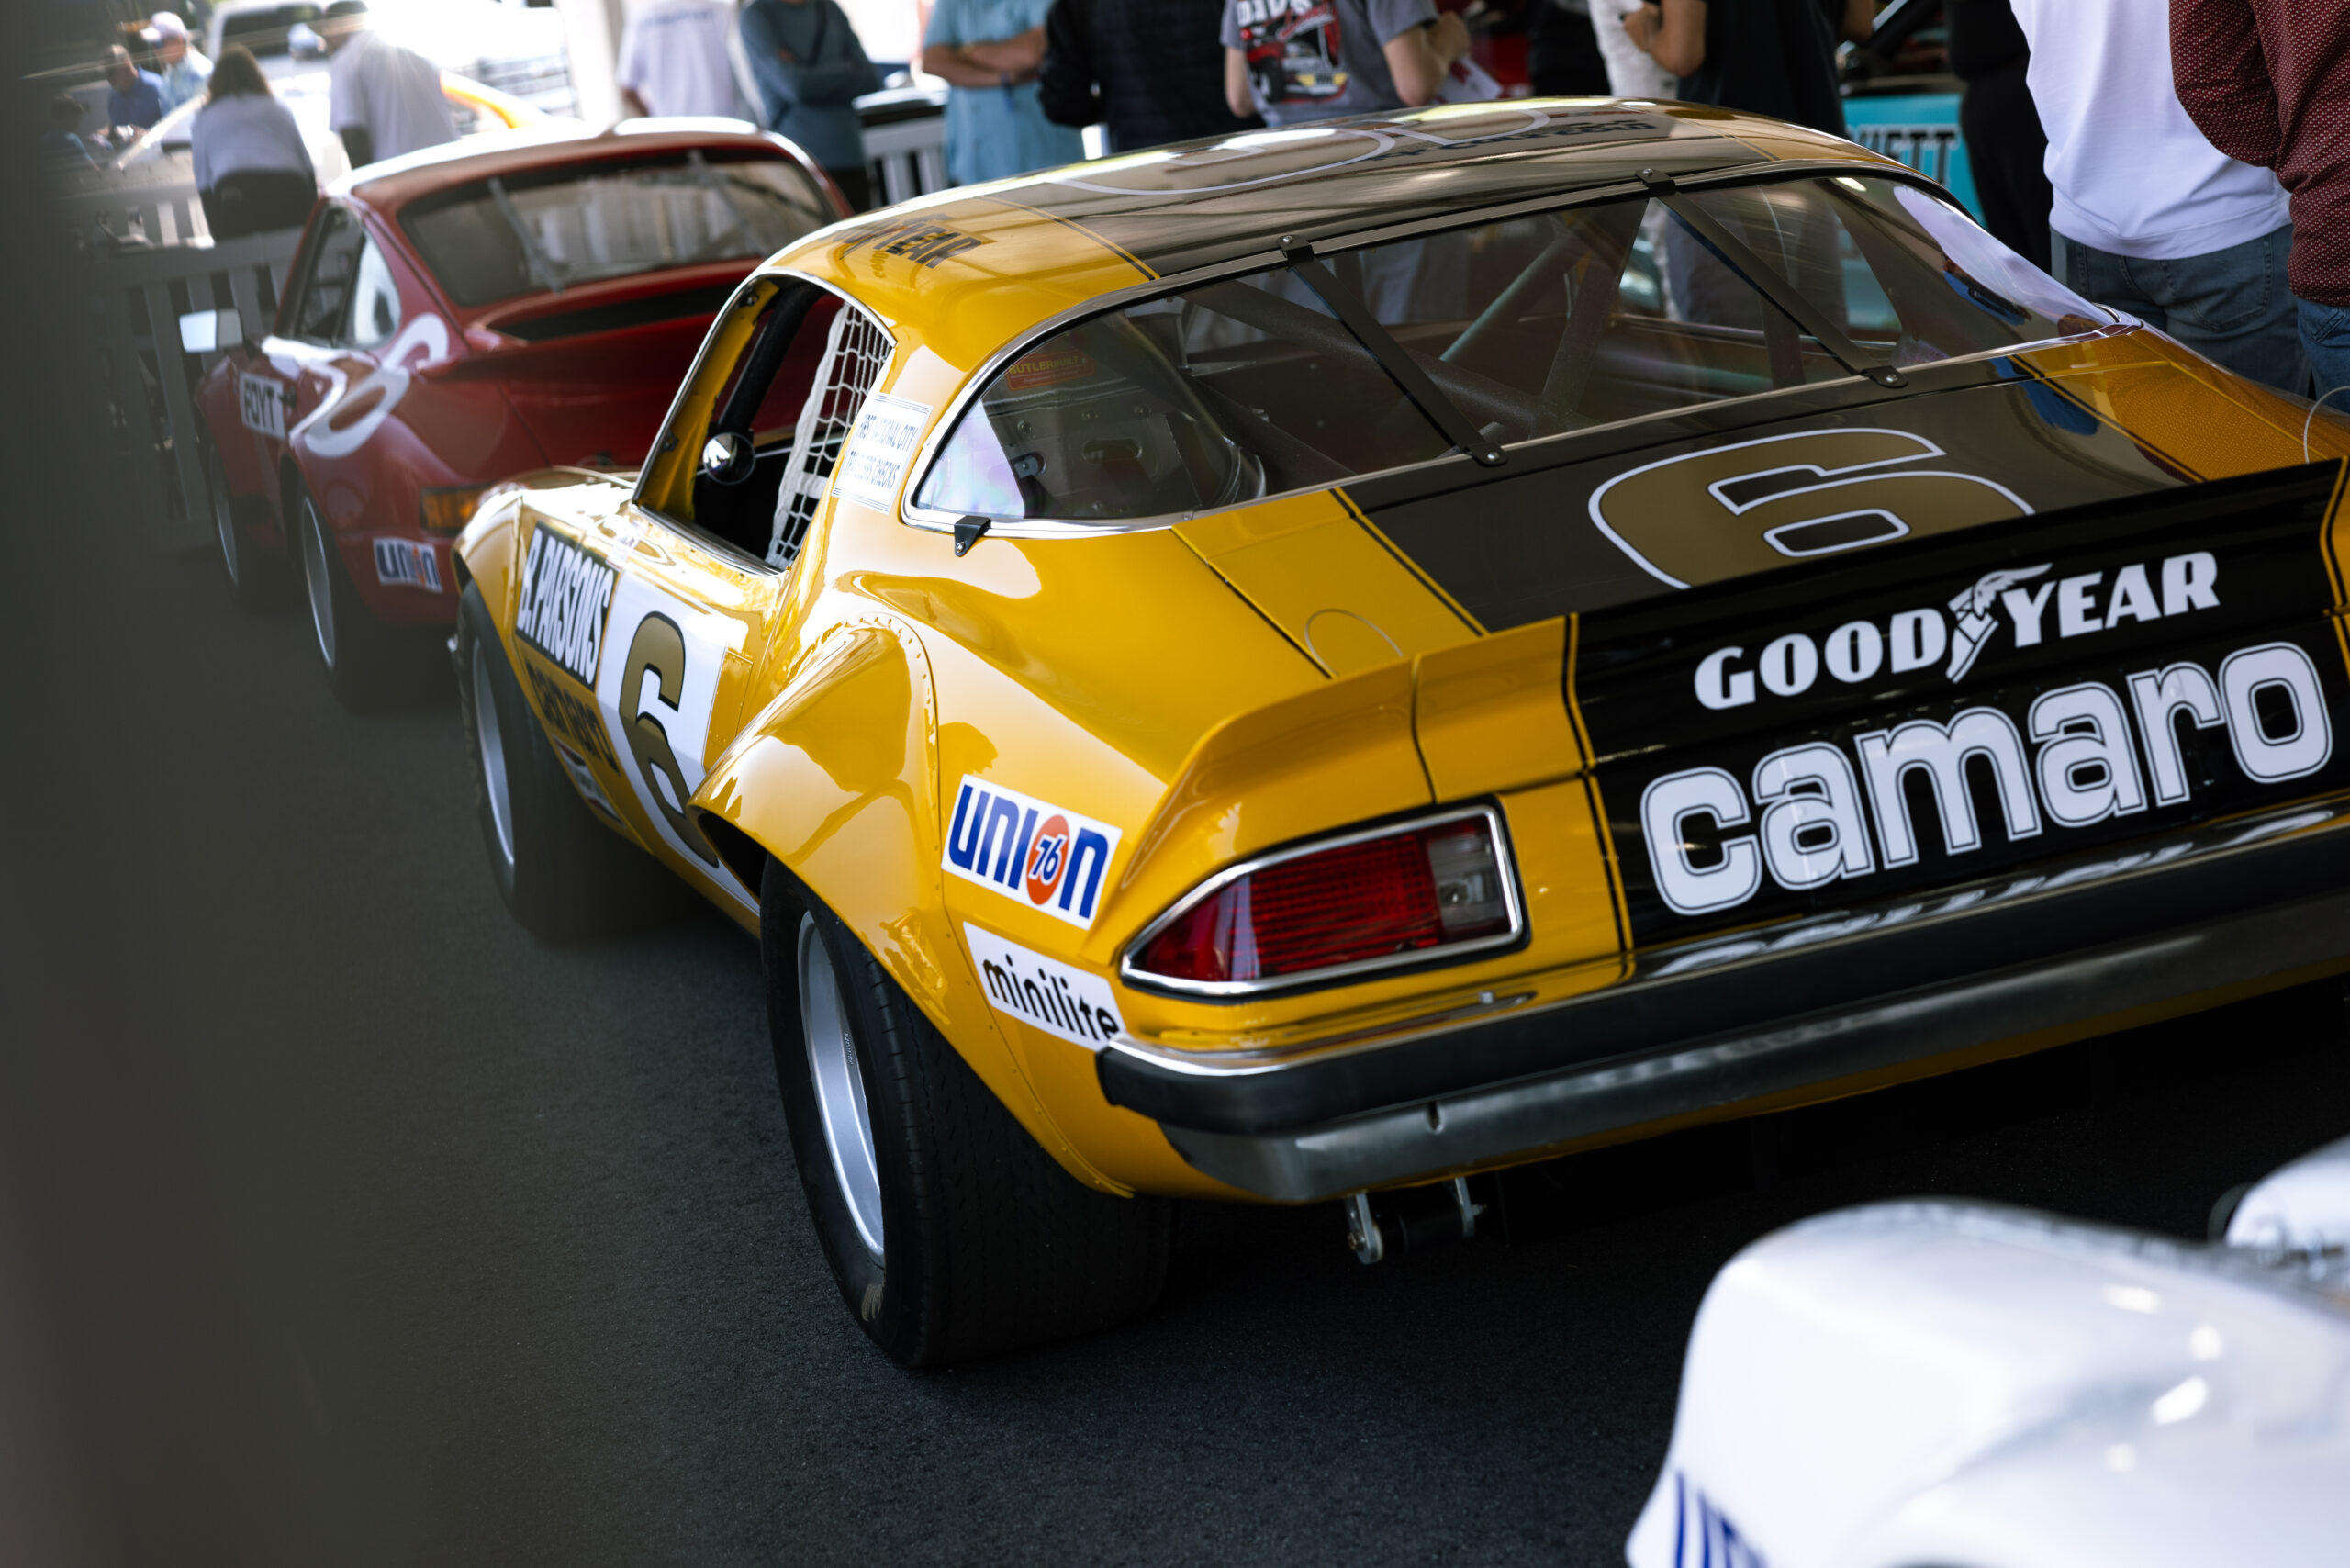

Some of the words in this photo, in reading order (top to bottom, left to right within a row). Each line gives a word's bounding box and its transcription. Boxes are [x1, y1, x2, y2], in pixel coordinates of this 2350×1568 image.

[243, 377, 274, 431] FOYT
[897, 425, 918, 451] CITY
[871, 459, 900, 489] CHECKS
[1588, 428, 2036, 588] 6
[619, 610, 720, 868] 6
[1640, 641, 2333, 915] camaro
[1029, 834, 1066, 884] 76
[982, 954, 1119, 1041] minilite
